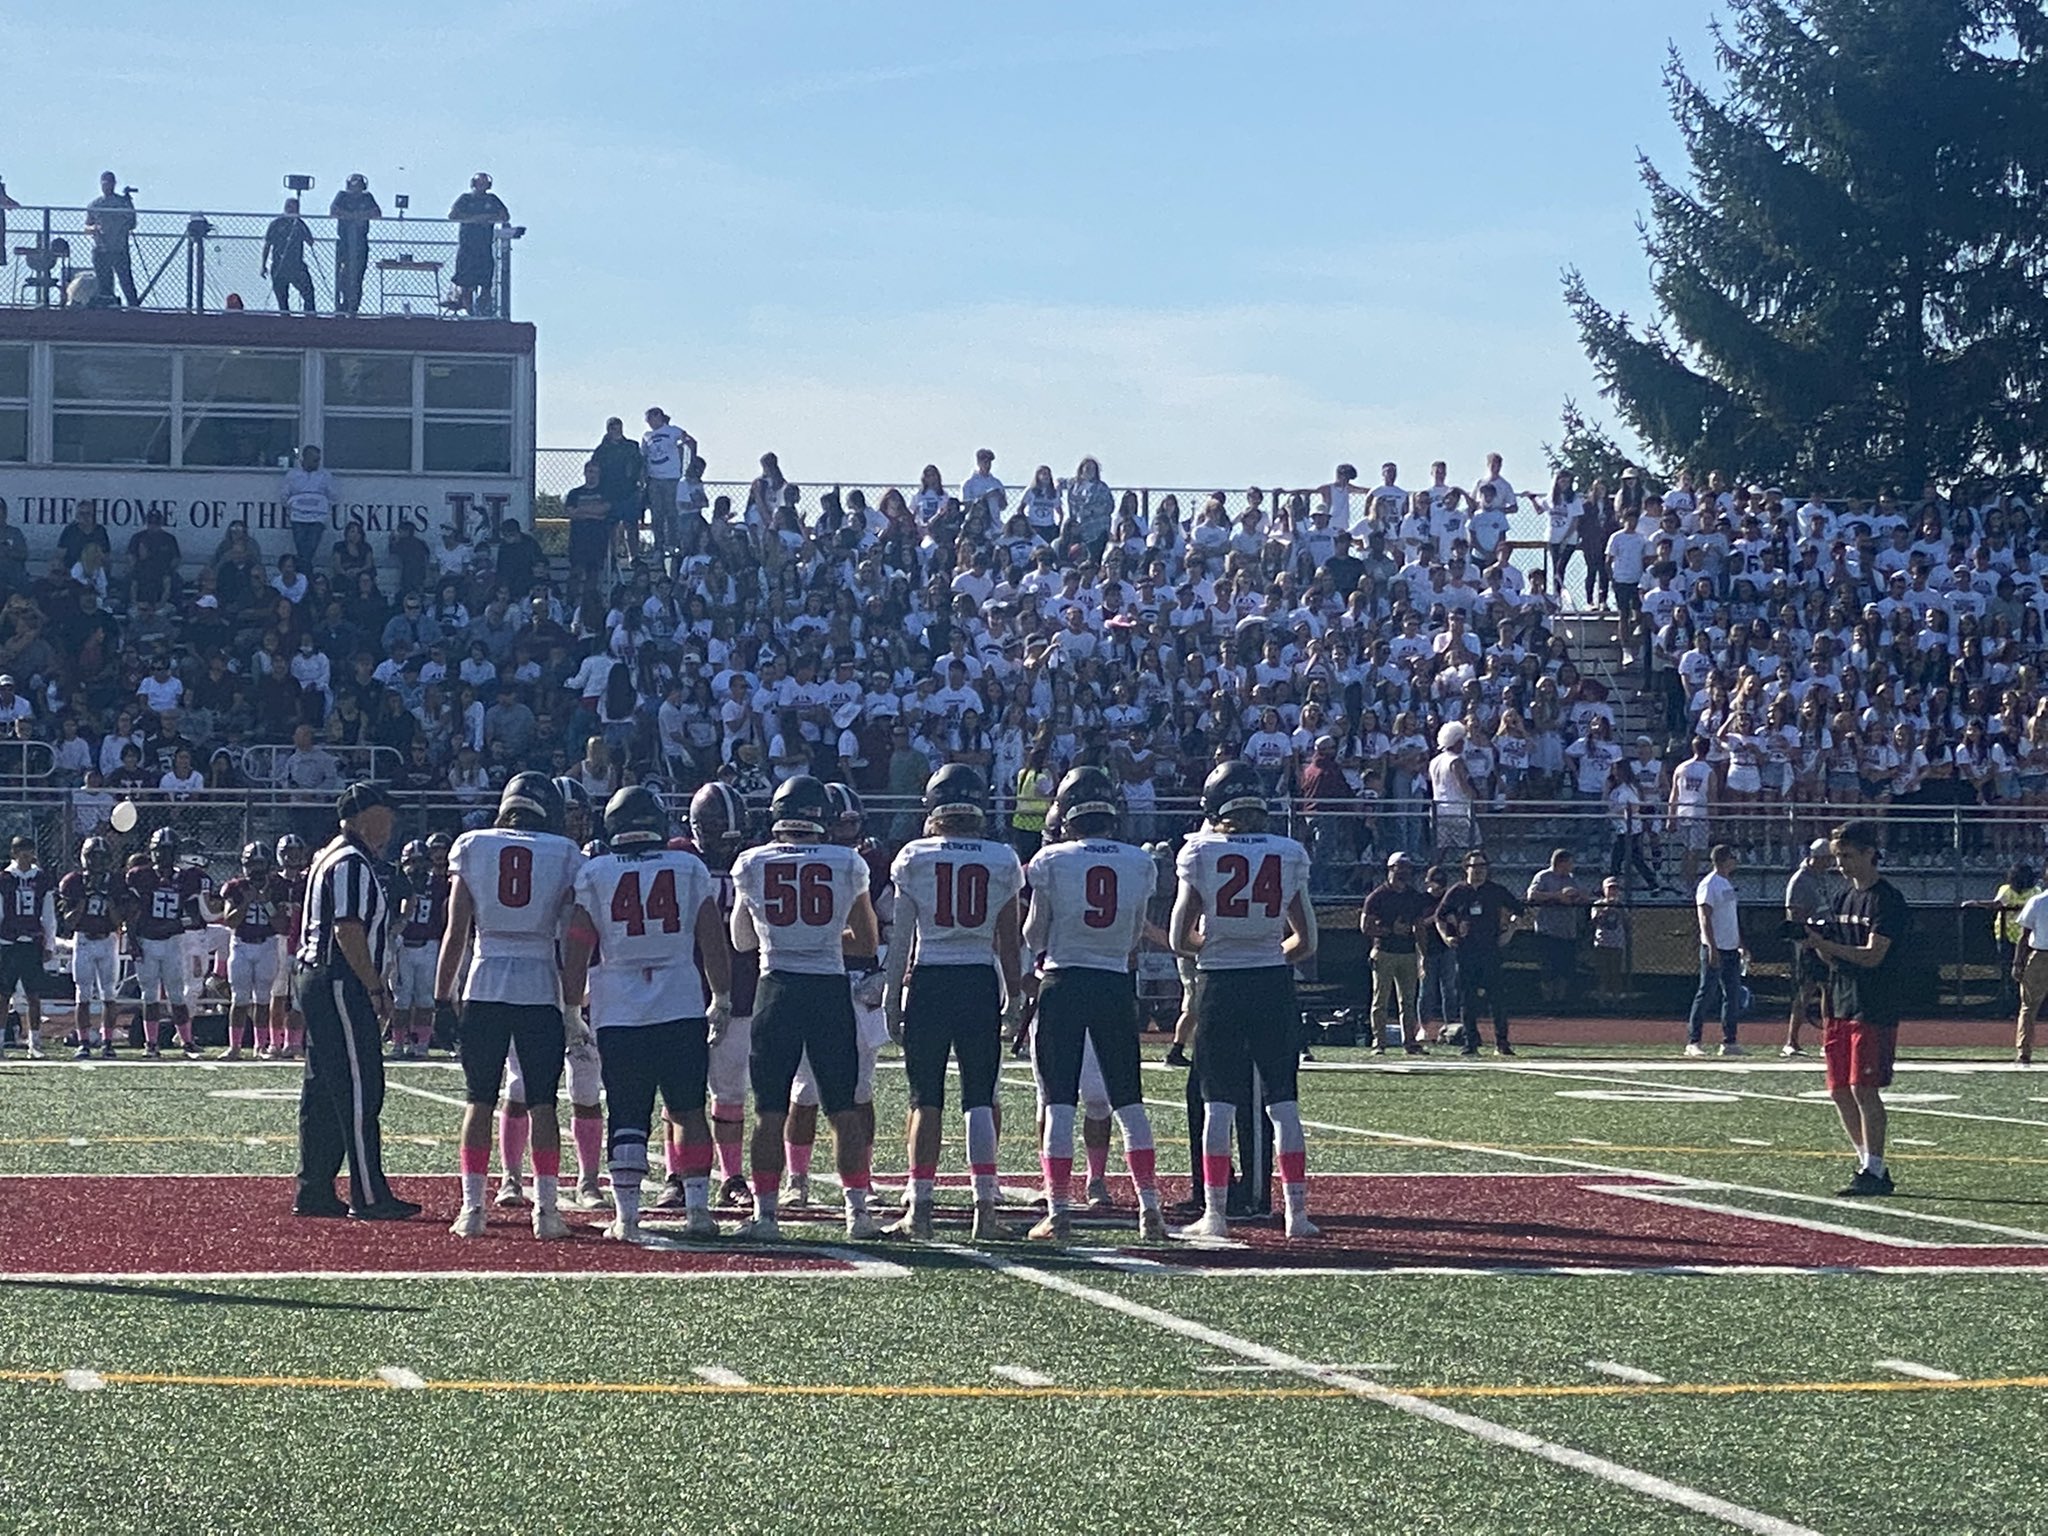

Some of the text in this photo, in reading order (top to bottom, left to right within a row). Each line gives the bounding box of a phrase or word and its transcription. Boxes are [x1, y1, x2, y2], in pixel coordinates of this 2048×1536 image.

[92, 498, 177, 527] HOME
[189, 501, 227, 529] OF
[330, 504, 429, 533] USKIES
[152, 891, 180, 919] 62
[497, 845, 533, 908] 8
[611, 869, 681, 937] 44
[764, 863, 834, 927] 56
[934, 862, 991, 929] 10
[1083, 865, 1119, 929] 9
[1216, 854, 1284, 919] 24
